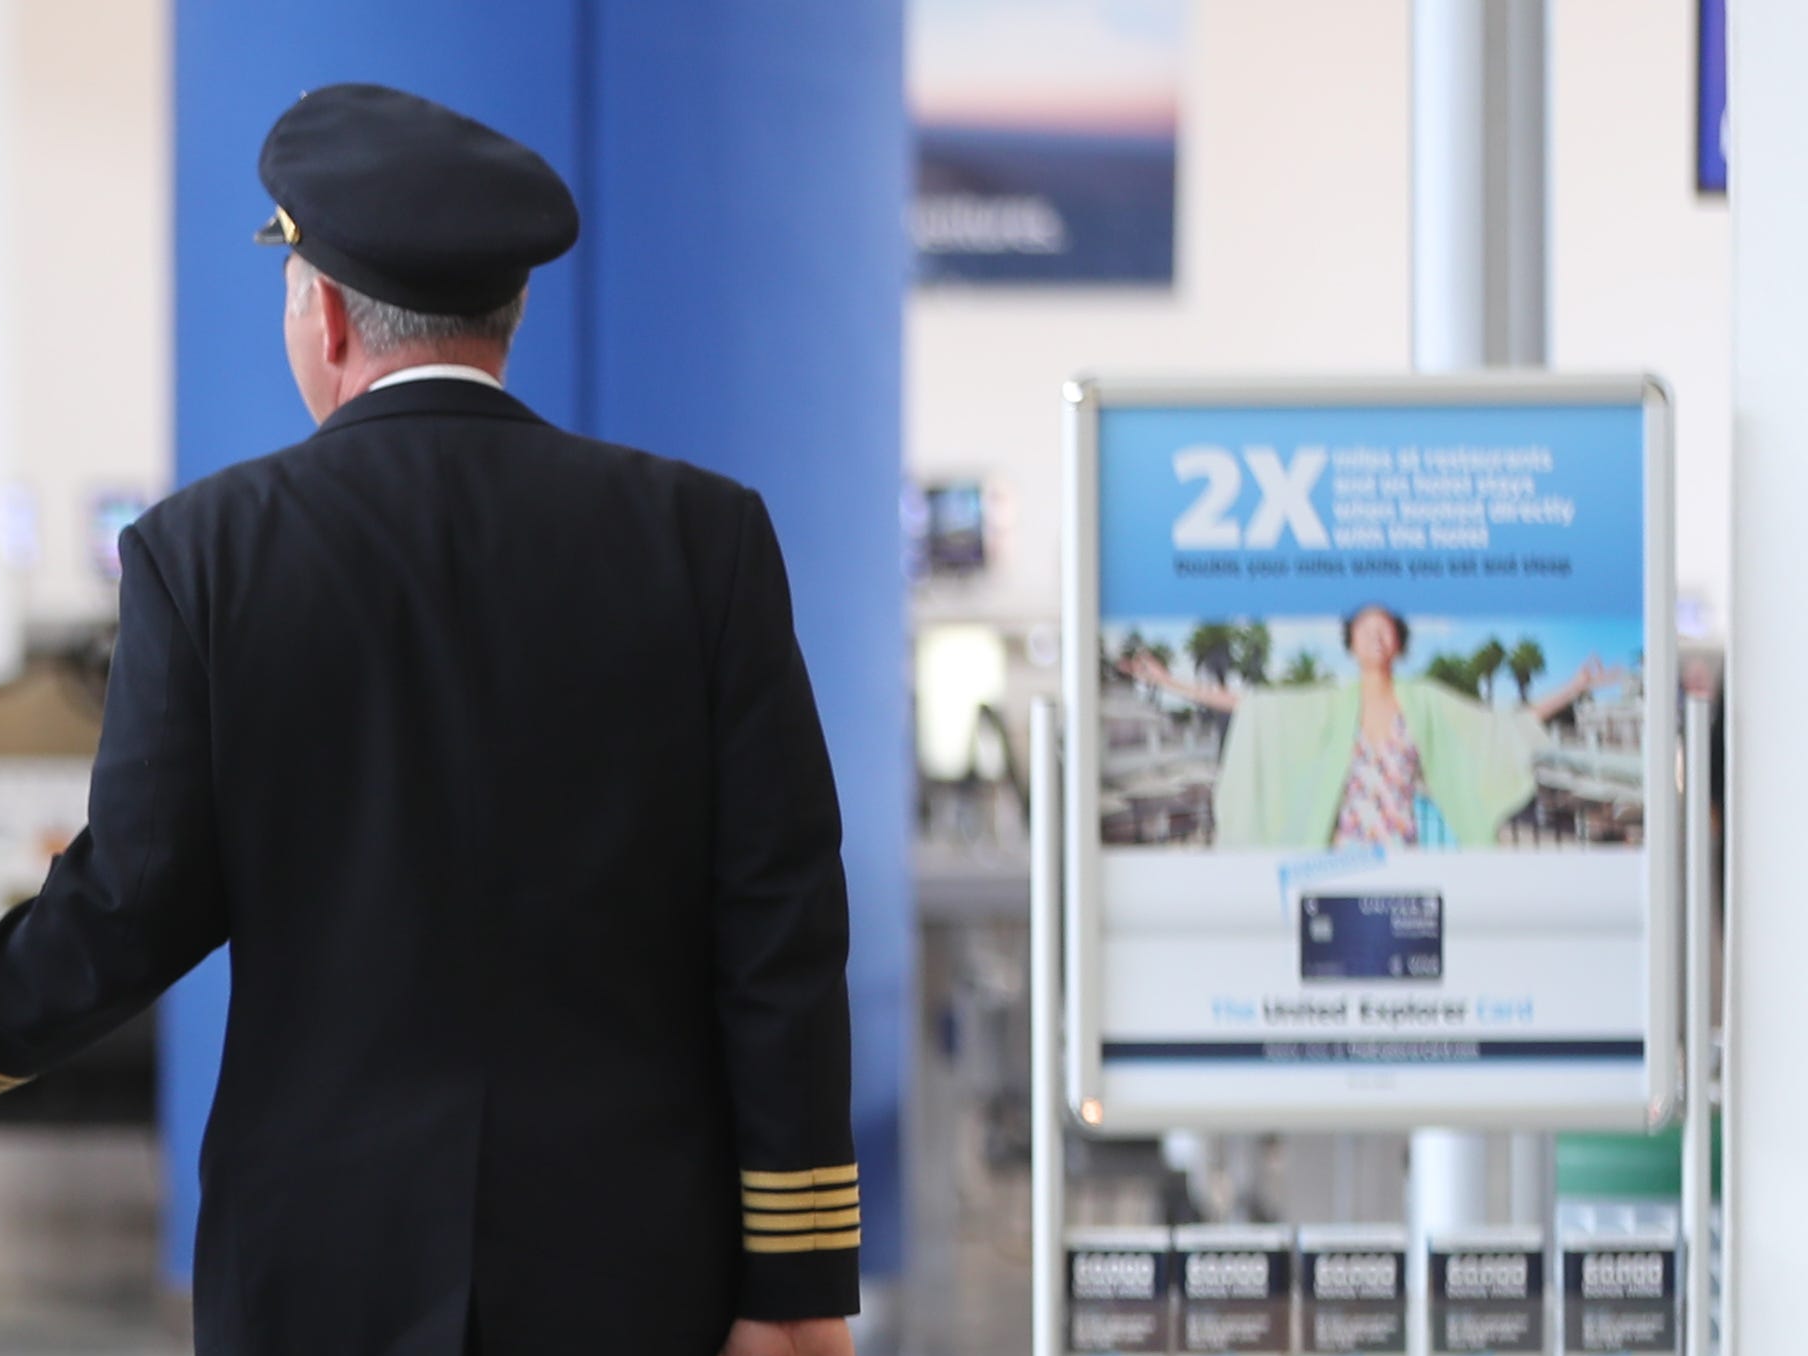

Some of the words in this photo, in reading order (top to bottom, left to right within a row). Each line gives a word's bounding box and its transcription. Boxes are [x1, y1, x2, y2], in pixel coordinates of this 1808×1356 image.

[1424, 446, 1554, 472] restaurants
[1173, 444, 1330, 550] 2X
[1488, 494, 1576, 527] directly
[1333, 524, 1385, 549] with
[1388, 524, 1426, 549] the
[1429, 523, 1489, 549] hotel
[1263, 995, 1346, 1024] United
[1360, 995, 1467, 1029] Explorer
[1476, 995, 1534, 1022] Card
